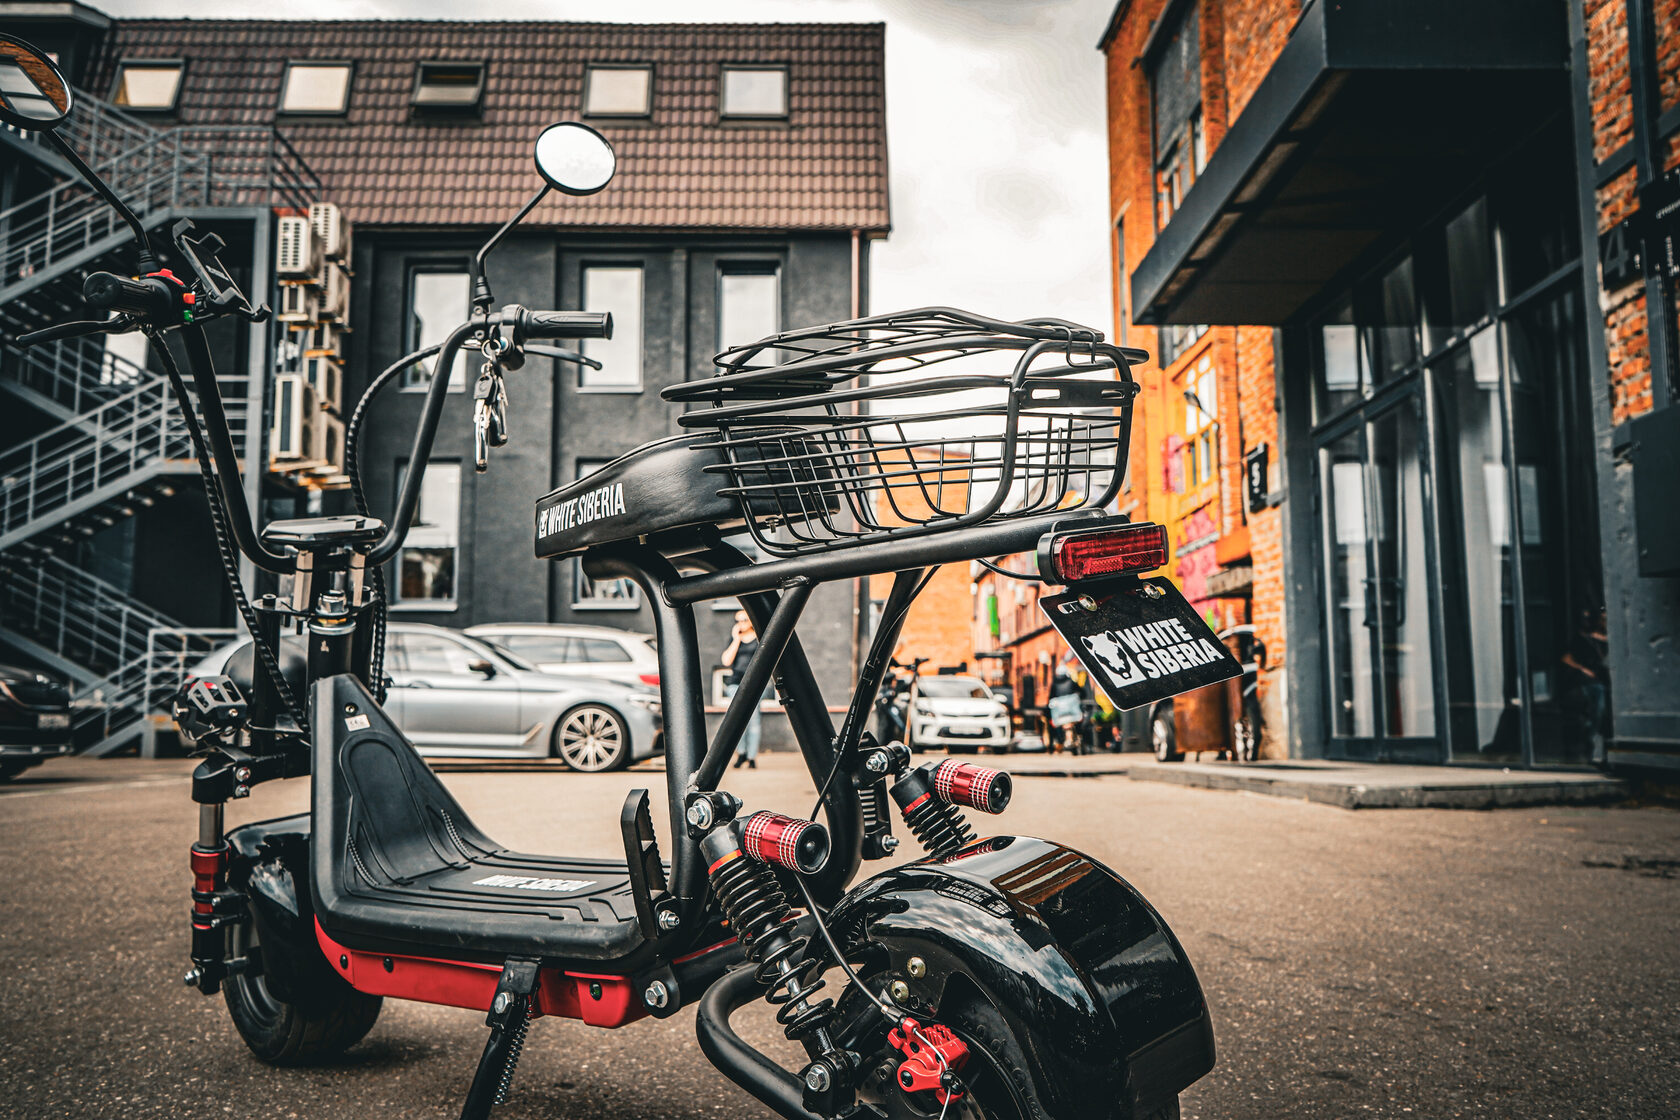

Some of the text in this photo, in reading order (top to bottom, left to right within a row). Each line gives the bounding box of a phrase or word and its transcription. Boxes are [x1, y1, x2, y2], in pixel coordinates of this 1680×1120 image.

[1604, 225, 1629, 278] 4
[548, 483, 627, 536] WHITE SIBERIA
[1115, 617, 1194, 654] WHITE
[1137, 638, 1226, 679] SIBERIA
